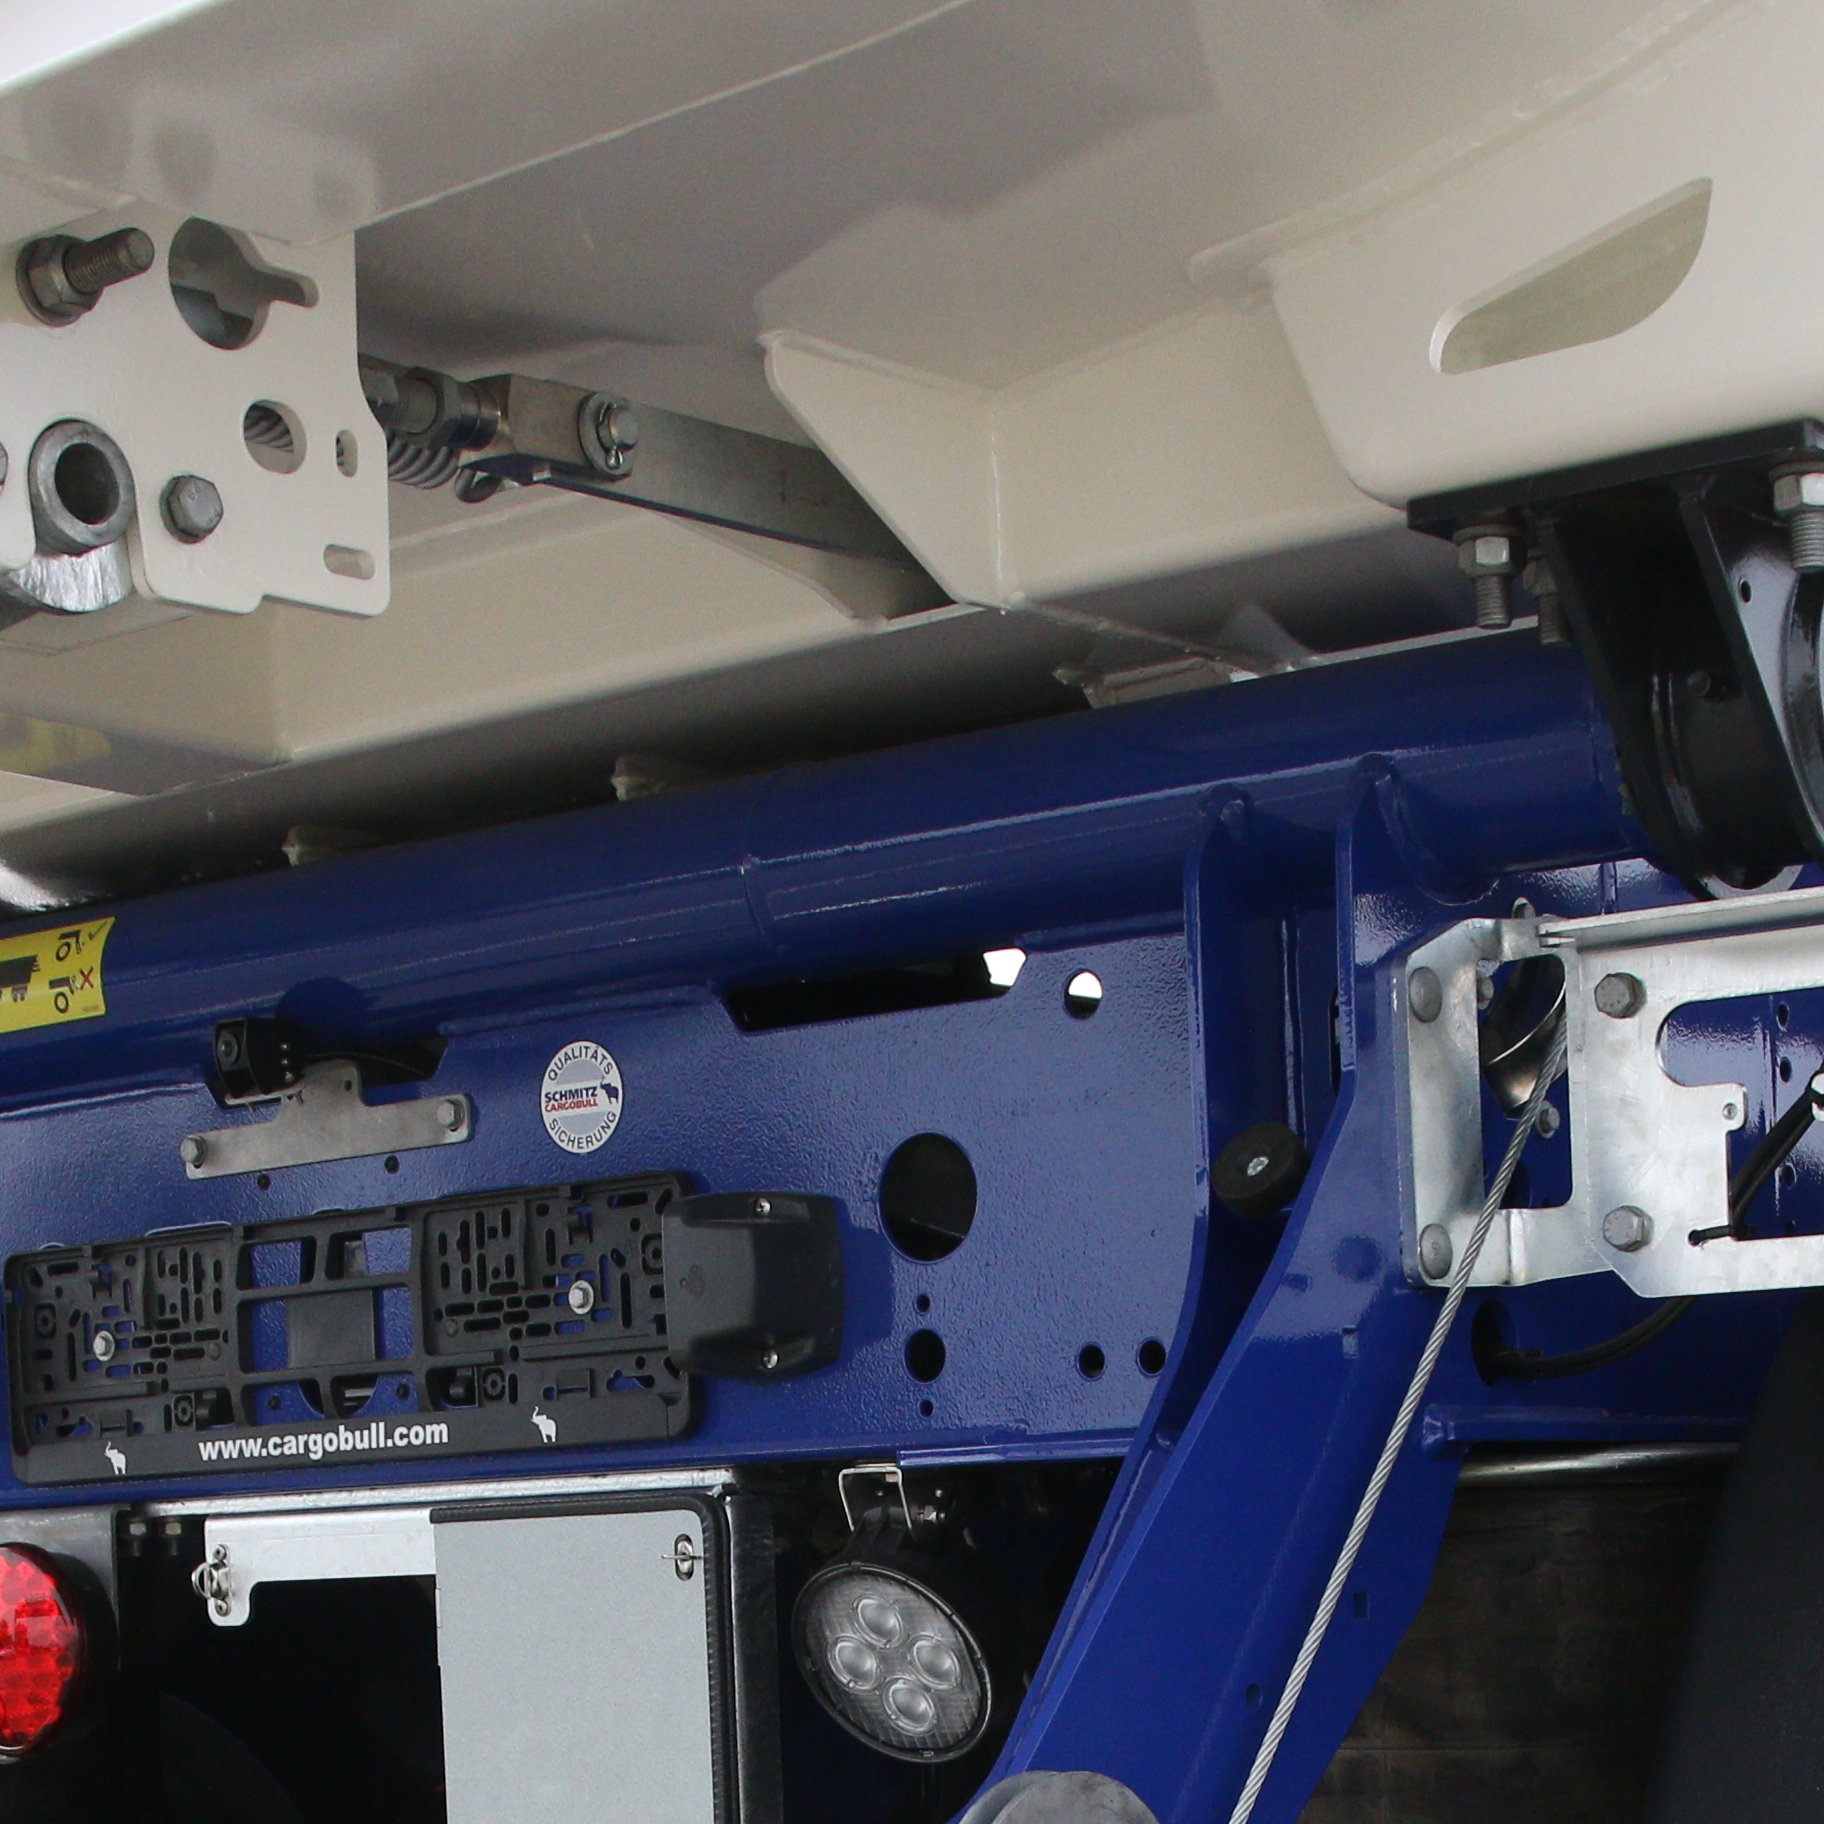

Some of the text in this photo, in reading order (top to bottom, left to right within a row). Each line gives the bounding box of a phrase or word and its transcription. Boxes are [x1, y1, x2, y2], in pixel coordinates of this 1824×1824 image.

[547, 1045, 614, 1082] QUALITÄTS
[544, 1086, 598, 1103] SCHMITZ
[544, 1098, 598, 1113] CARGOBULL
[549, 1111, 617, 1149] SICHERUNG
[198, 1421, 449, 1461] www.cargobull.com
